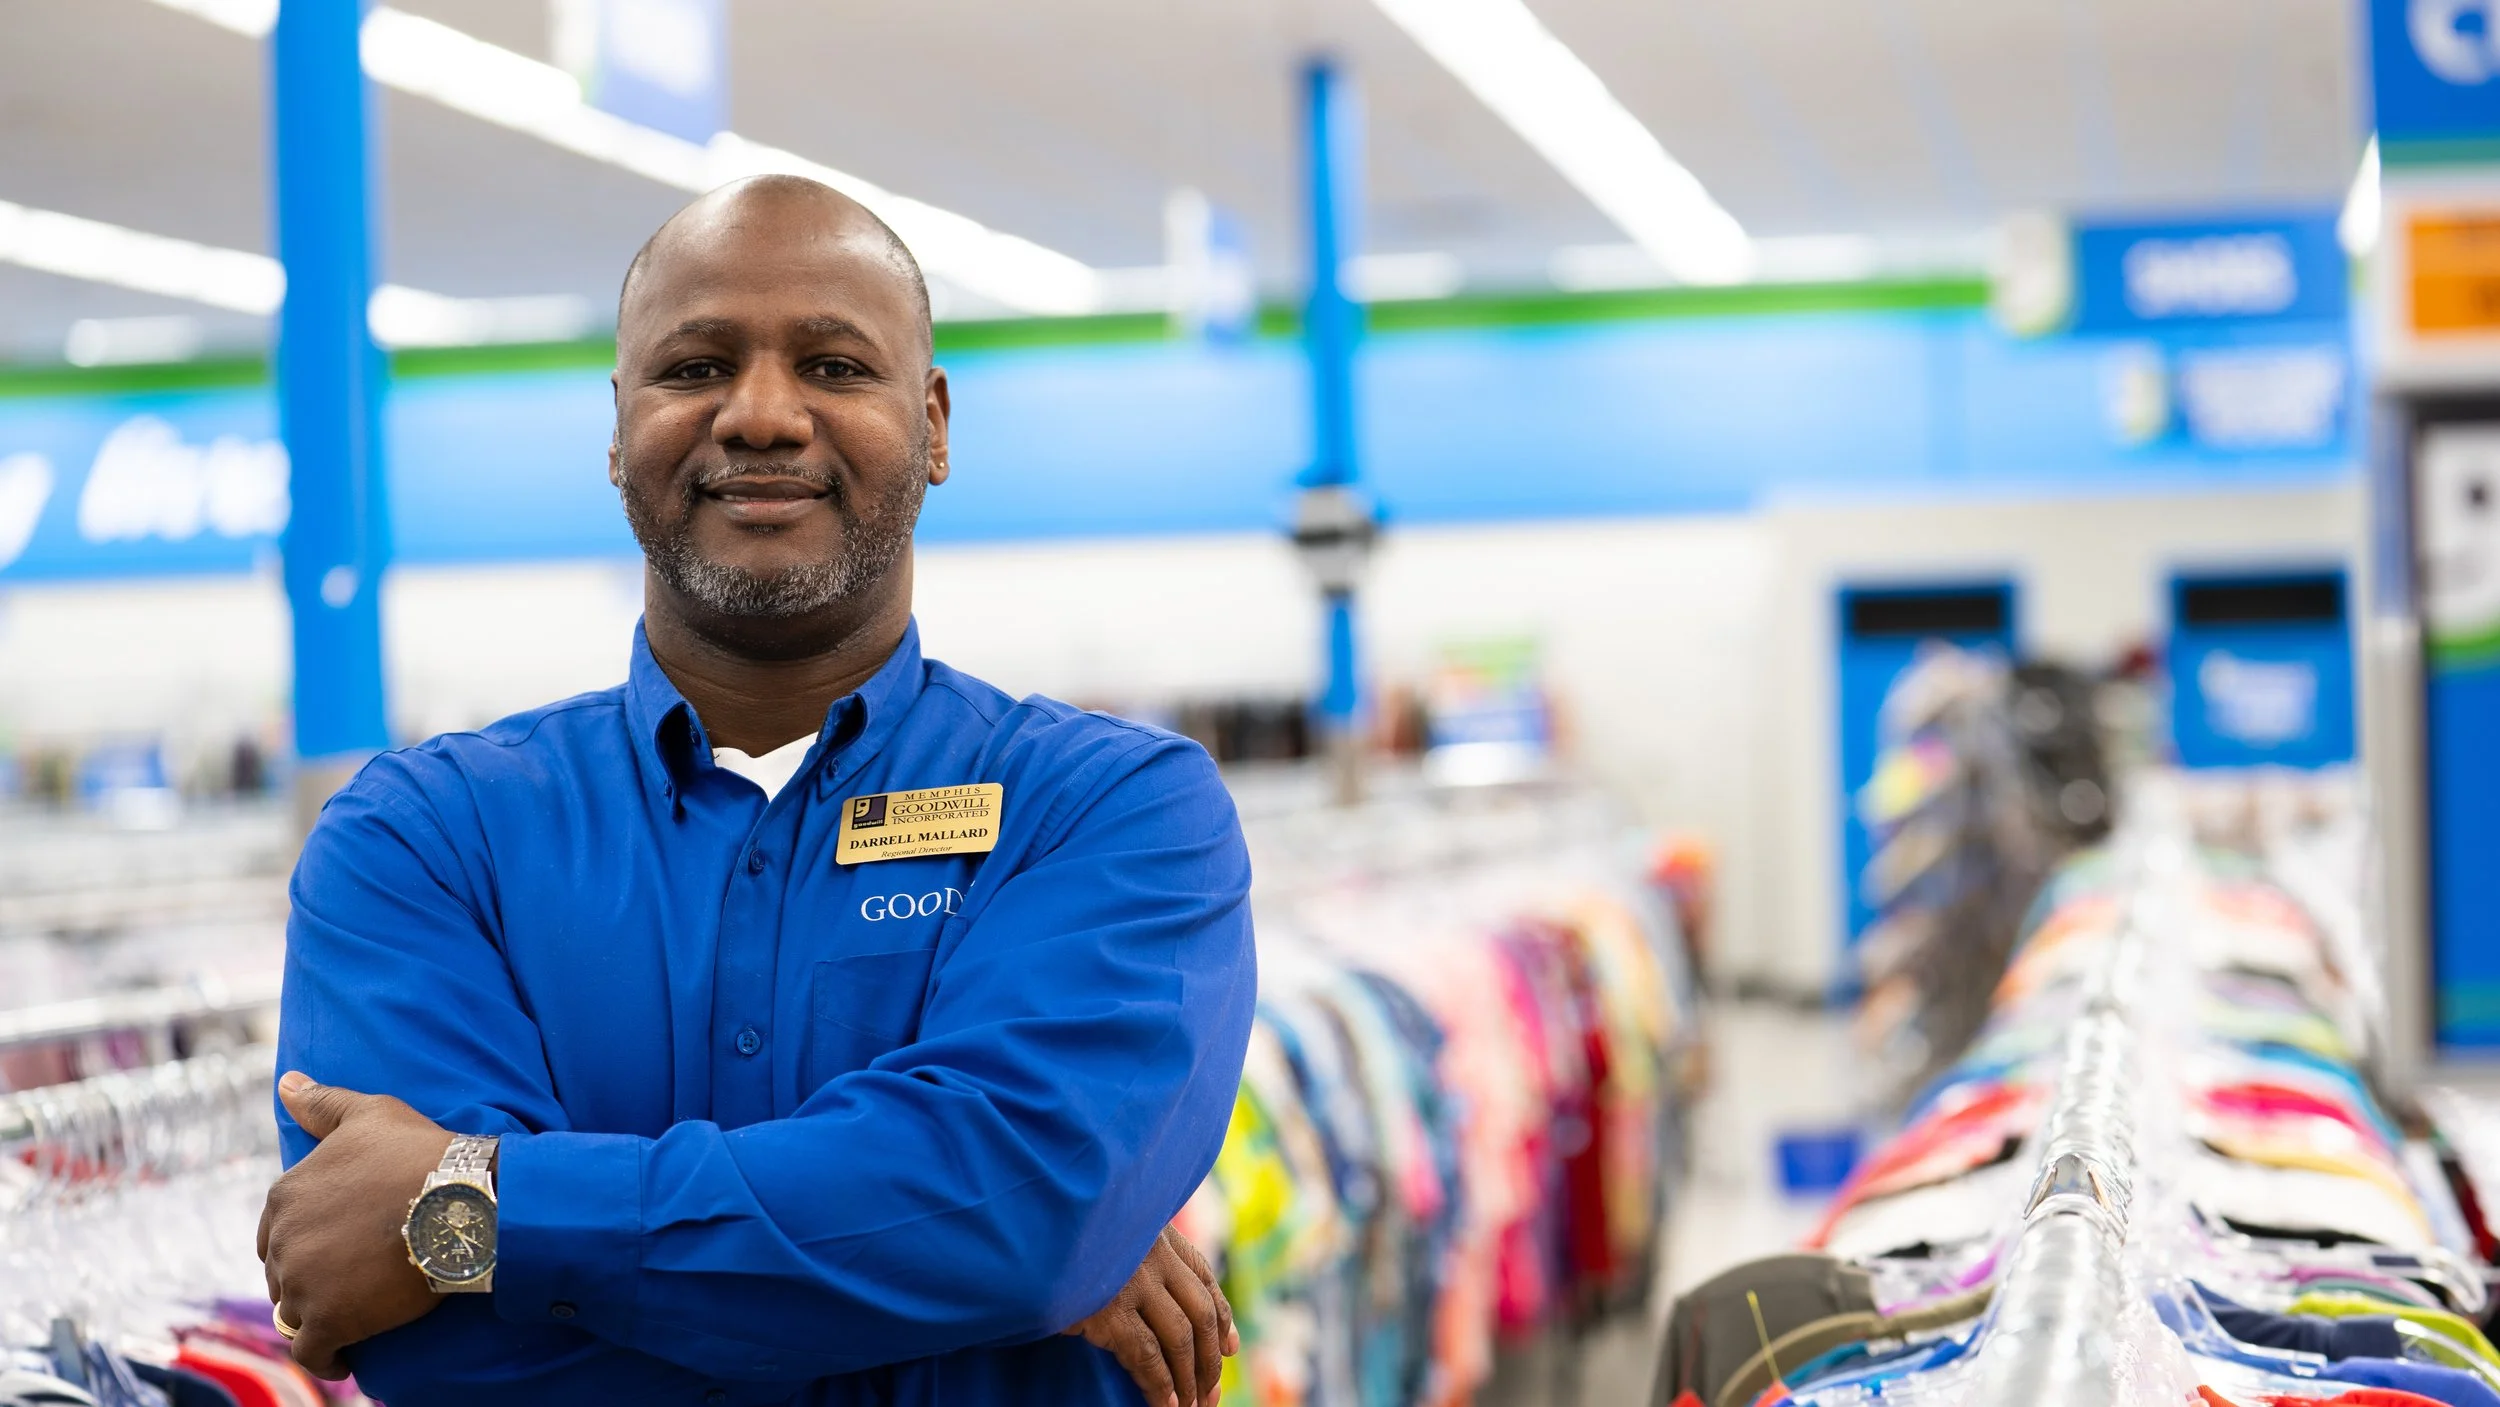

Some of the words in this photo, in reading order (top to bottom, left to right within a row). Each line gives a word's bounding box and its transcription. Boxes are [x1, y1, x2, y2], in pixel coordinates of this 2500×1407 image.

[905, 787, 982, 800] MEMPHIS
[892, 798, 990, 815] GOODWILL
[893, 810, 989, 825] INCORPORATED
[850, 834, 916, 850] DARRELL
[918, 828, 988, 842] MALLARD
[881, 848, 916, 858] Regional
[918, 845, 953, 853] Director
[861, 880, 976, 921] GOOD
